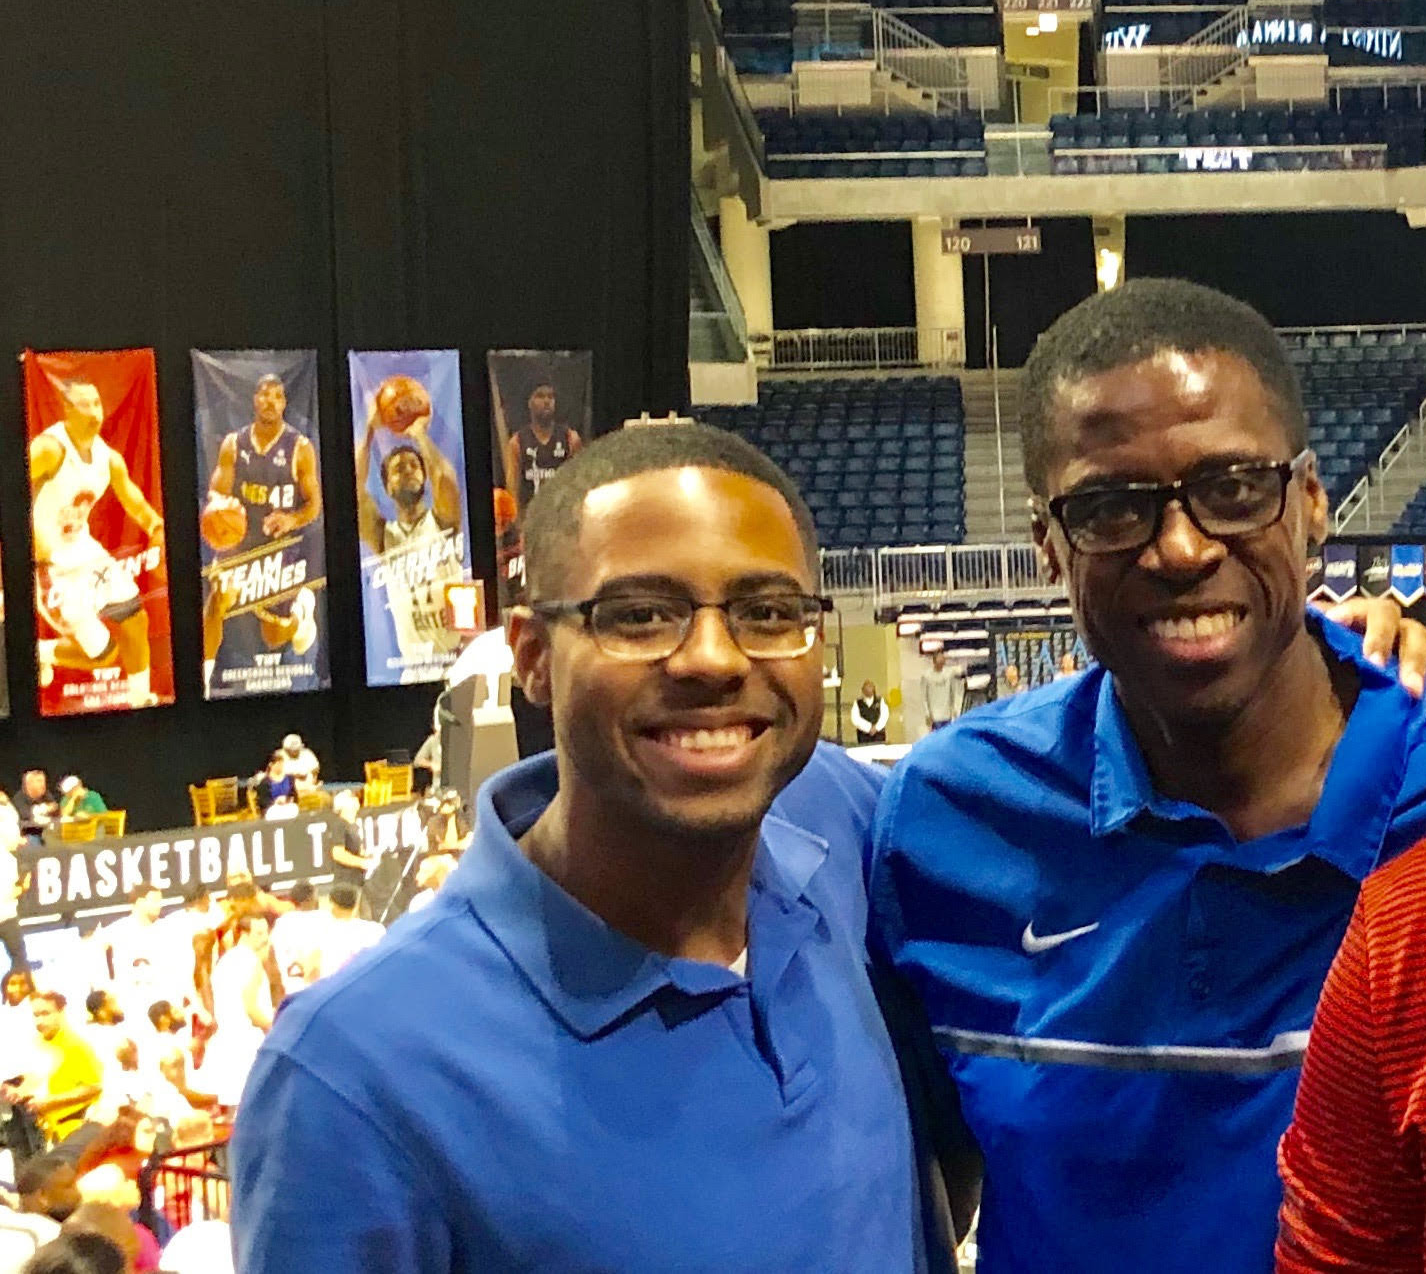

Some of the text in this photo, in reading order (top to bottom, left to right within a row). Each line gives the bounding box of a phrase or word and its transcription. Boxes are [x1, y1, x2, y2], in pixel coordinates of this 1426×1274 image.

[945, 235, 1038, 252] 120 121
[269, 483, 295, 508] 42
[219, 551, 284, 594] TEAM
[239, 559, 307, 606] HINES
[37, 828, 294, 906] BASKETBALL
